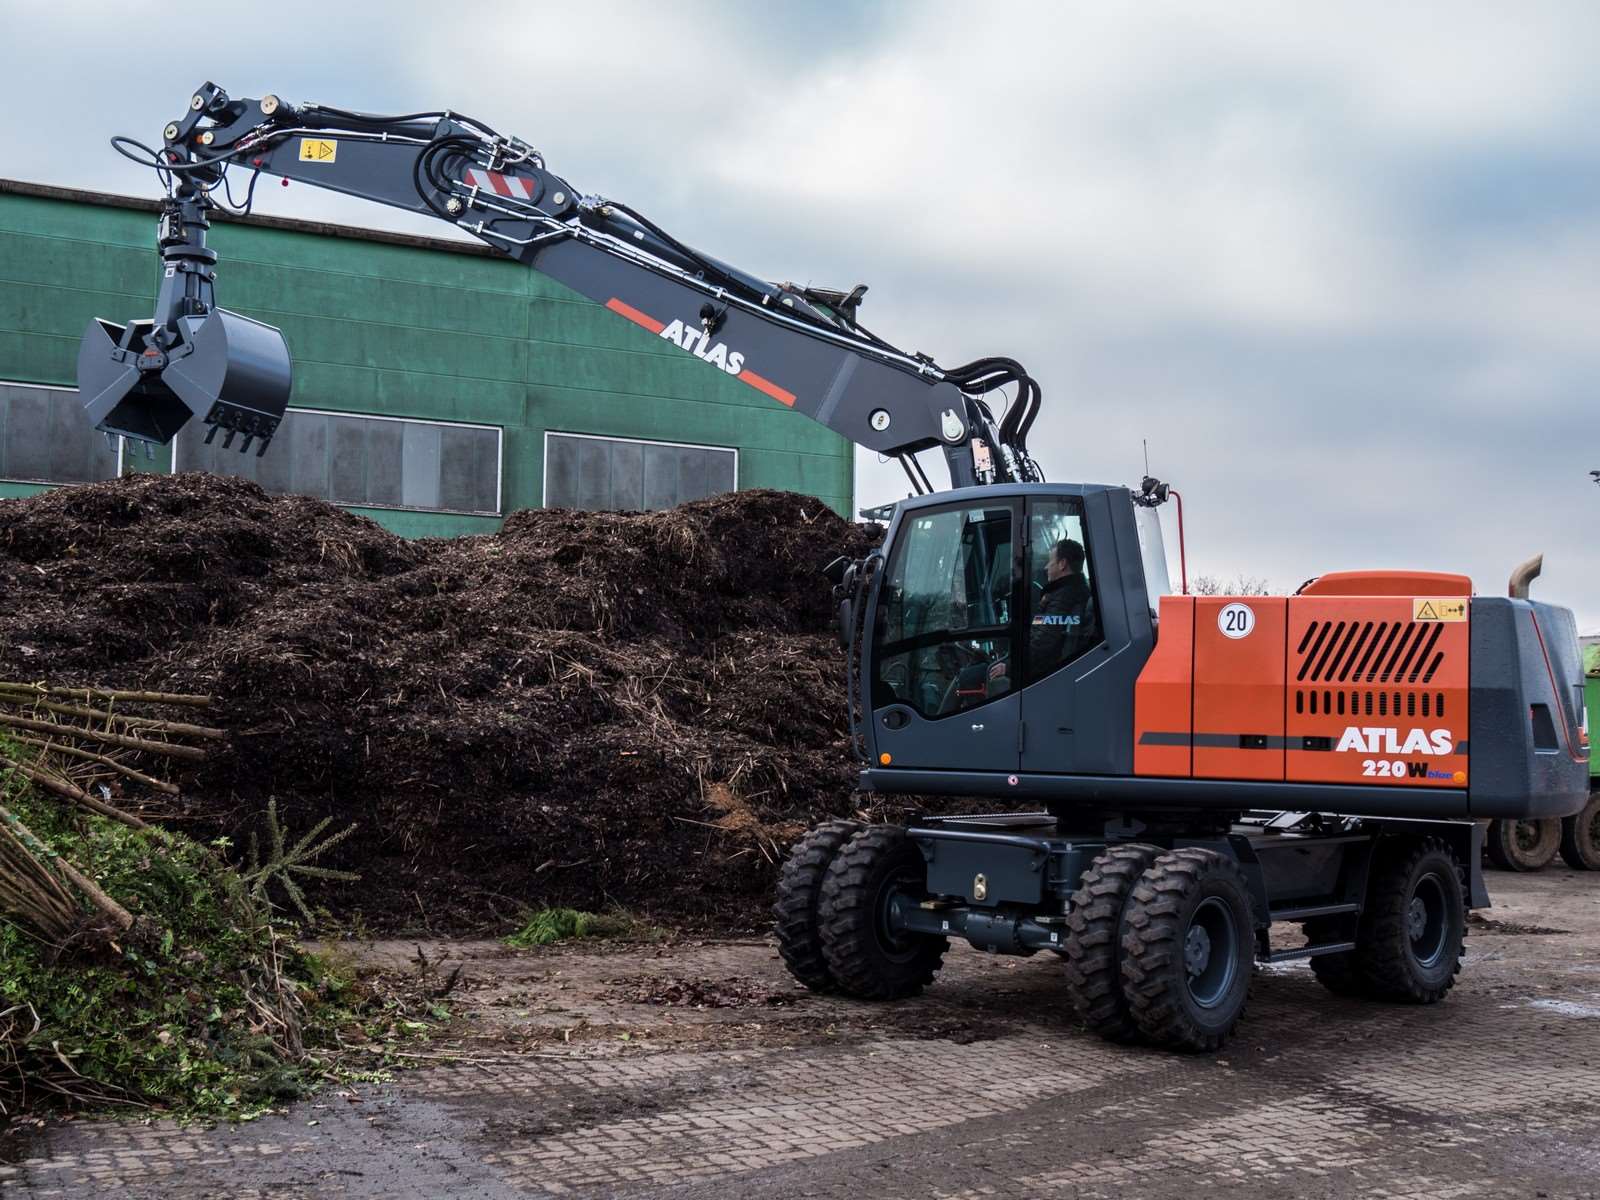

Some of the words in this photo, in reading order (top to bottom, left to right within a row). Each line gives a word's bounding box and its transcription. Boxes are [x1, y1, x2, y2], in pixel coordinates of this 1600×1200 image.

[659, 319, 745, 375] ATLAS
[1043, 615, 1081, 625] ATLAS
[1226, 610, 1247, 631] 20
[1335, 726, 1453, 755] ATLAS
